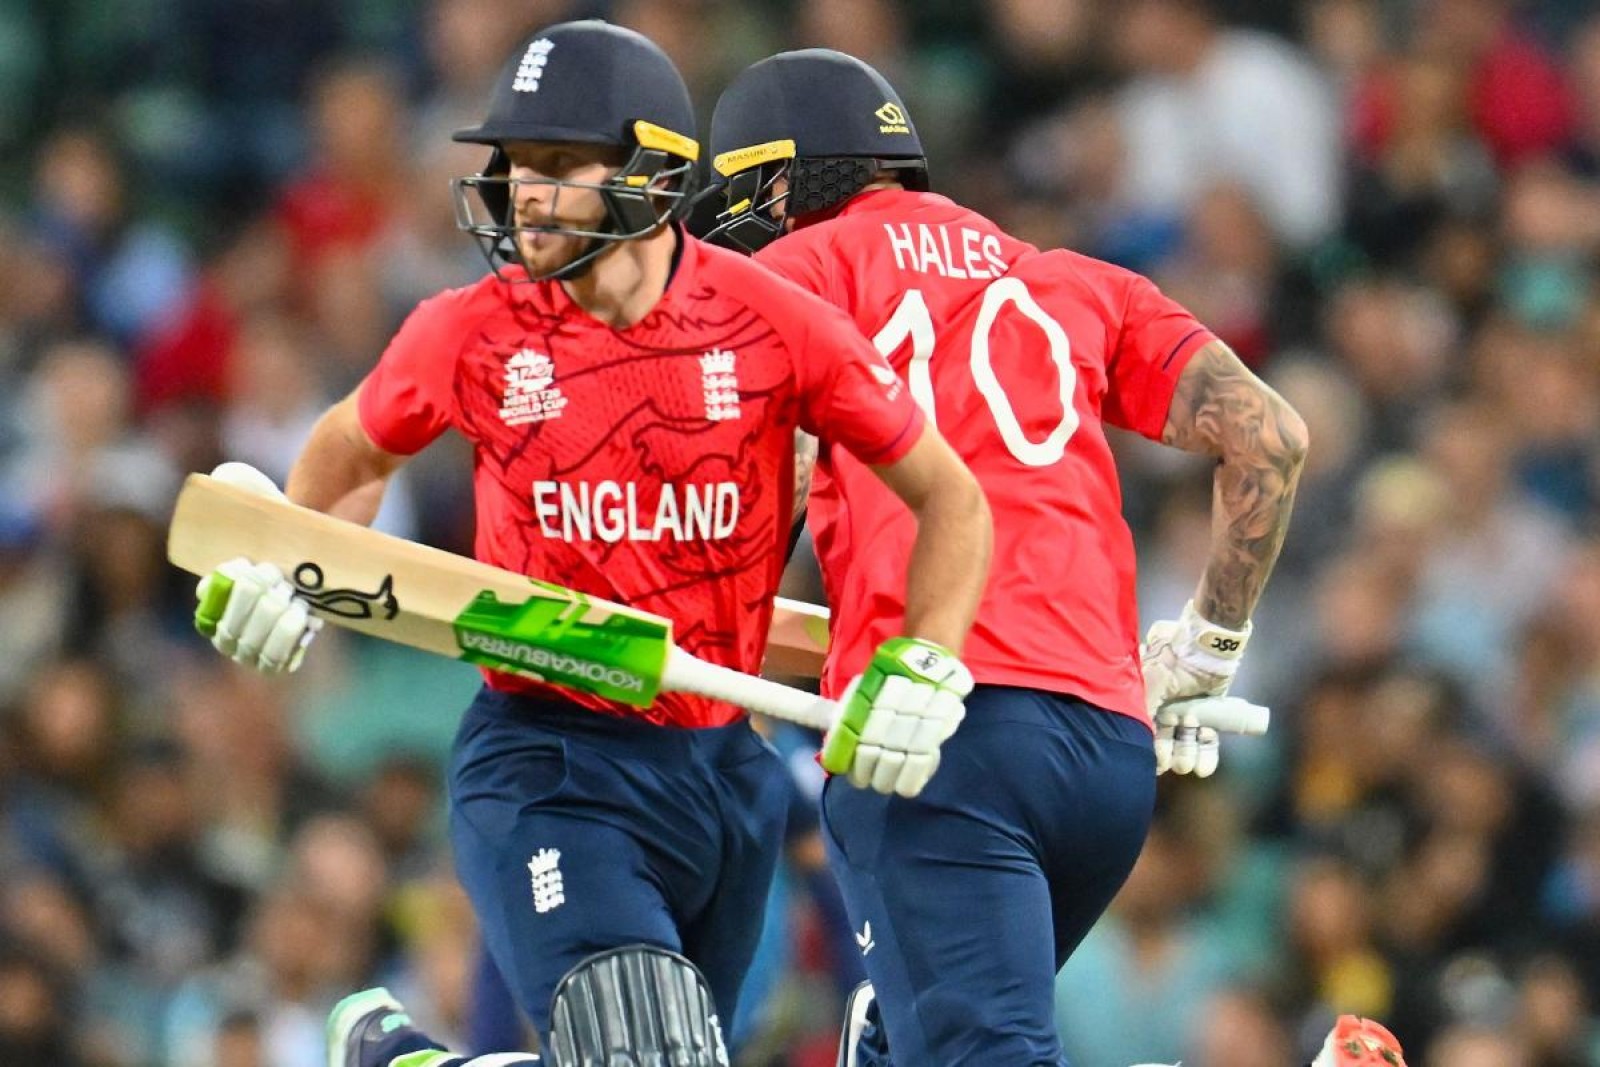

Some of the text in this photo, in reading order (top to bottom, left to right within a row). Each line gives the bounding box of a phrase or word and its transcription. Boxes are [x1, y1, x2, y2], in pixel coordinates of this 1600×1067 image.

[884, 223, 1009, 279] HALES
[872, 277, 1079, 466] 10
[532, 480, 740, 544] ENGLAND
[462, 630, 645, 693] KOOKABURRA
